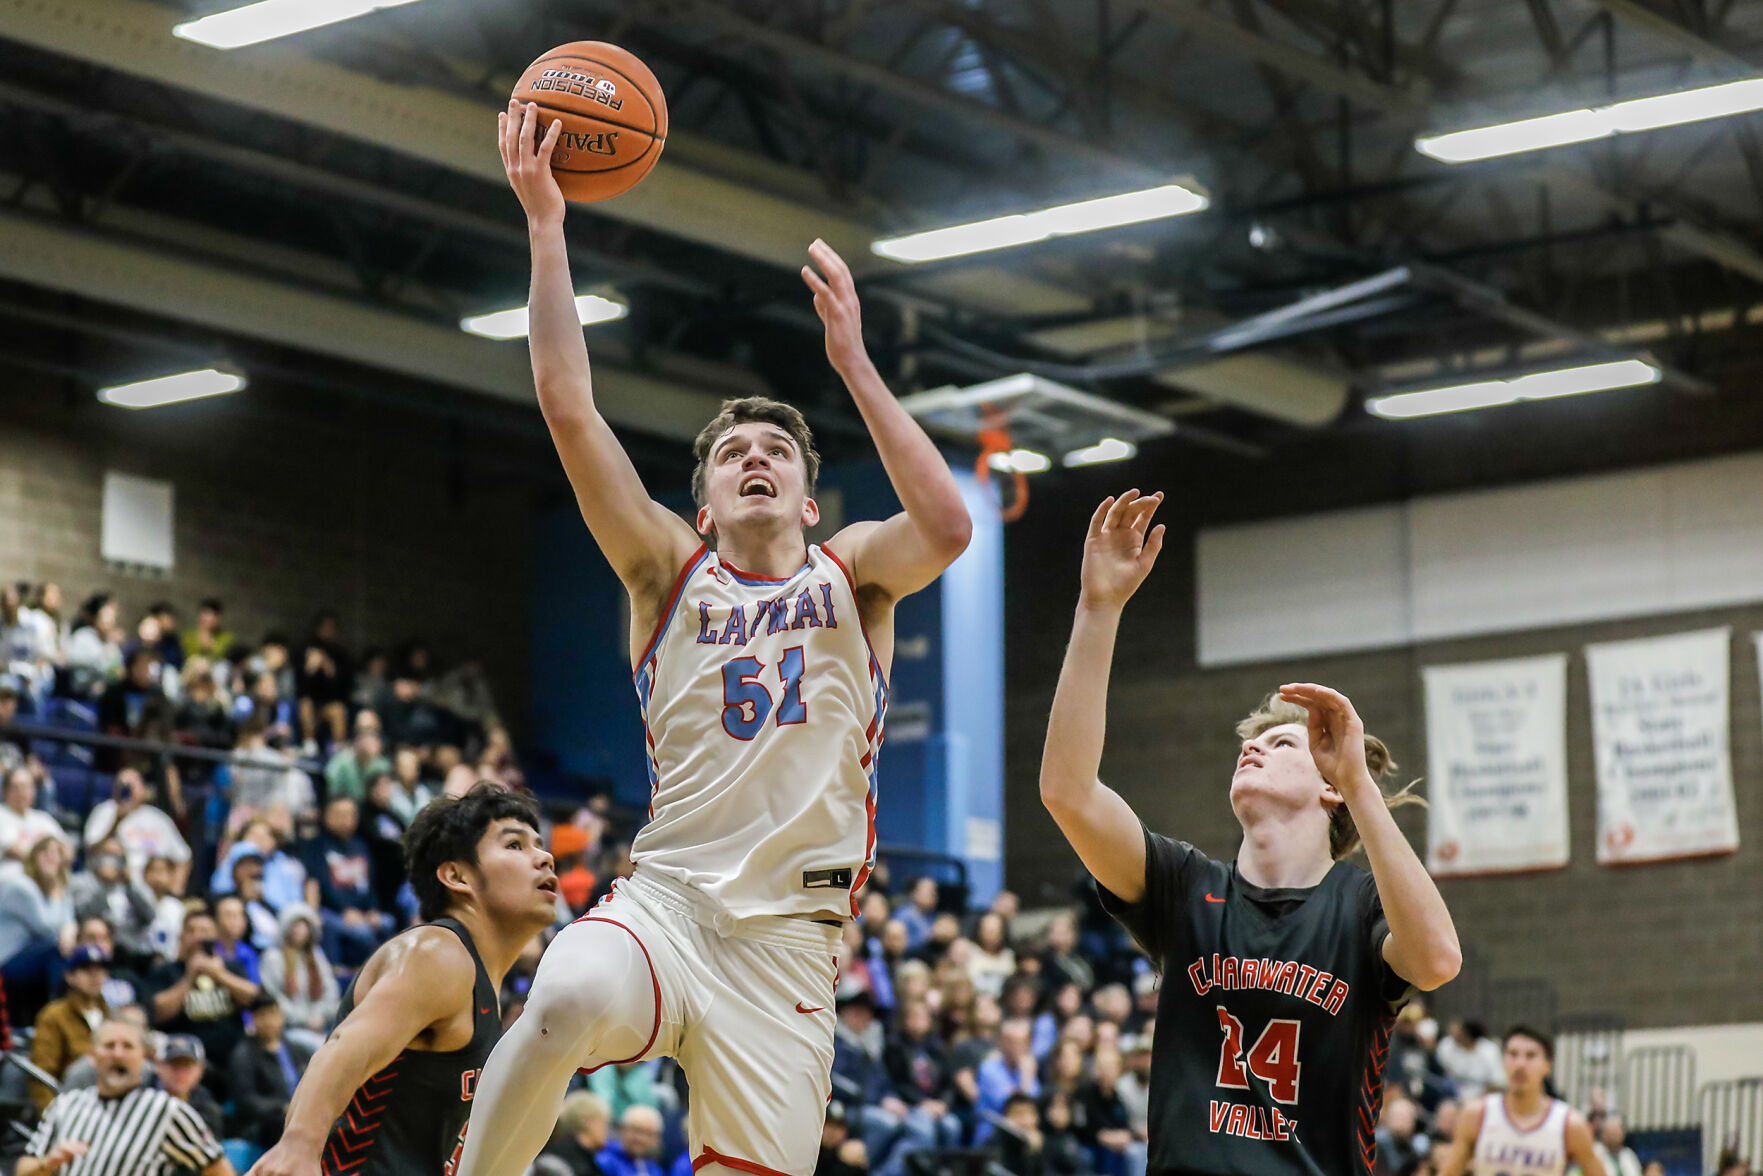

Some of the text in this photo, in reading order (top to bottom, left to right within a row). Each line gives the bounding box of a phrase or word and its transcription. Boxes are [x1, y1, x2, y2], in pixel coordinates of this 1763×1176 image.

[530, 78, 624, 112] PRECISION
[721, 645, 807, 741] 51
[1215, 1005, 1301, 1105] 24
